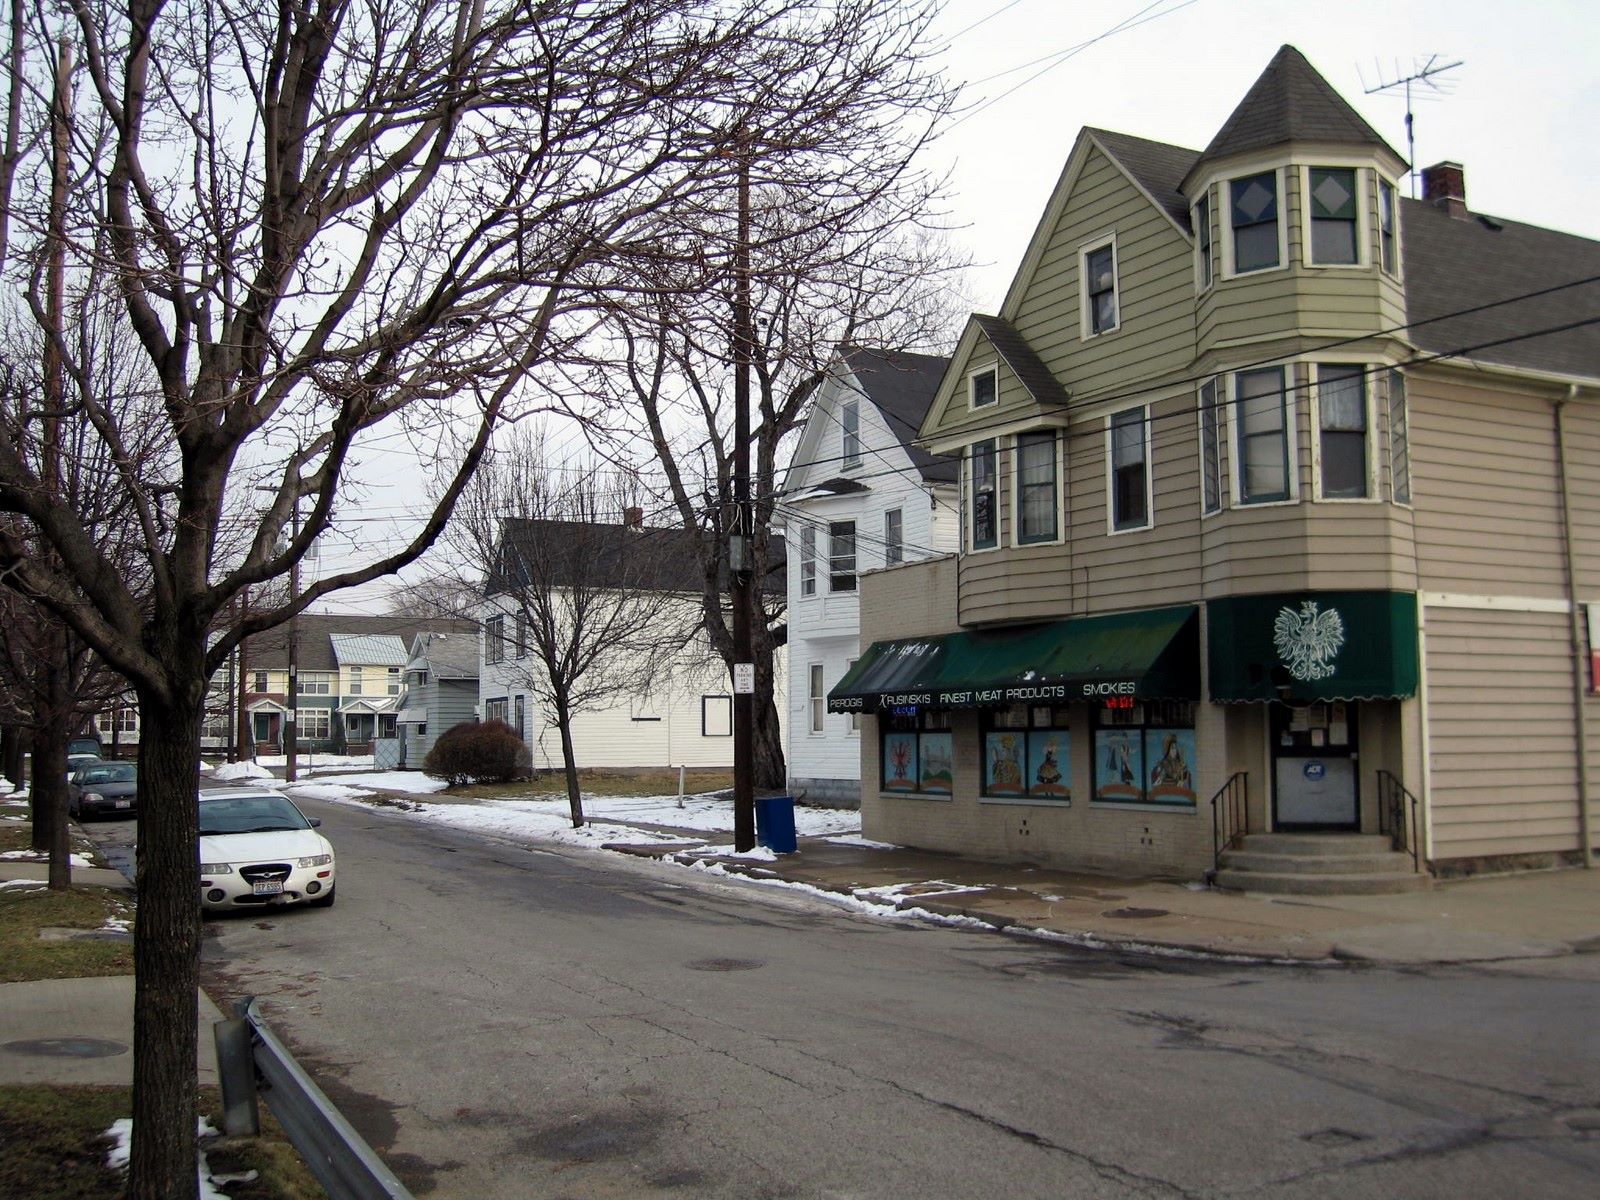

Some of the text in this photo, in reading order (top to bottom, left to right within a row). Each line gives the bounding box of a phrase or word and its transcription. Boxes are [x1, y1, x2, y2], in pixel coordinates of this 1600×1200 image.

[939, 692, 972, 703] FINEST
[975, 689, 1003, 702] MEAT
[1006, 685, 1065, 700] PRODUCTS
[1082, 682, 1136, 696] SMOKIES
